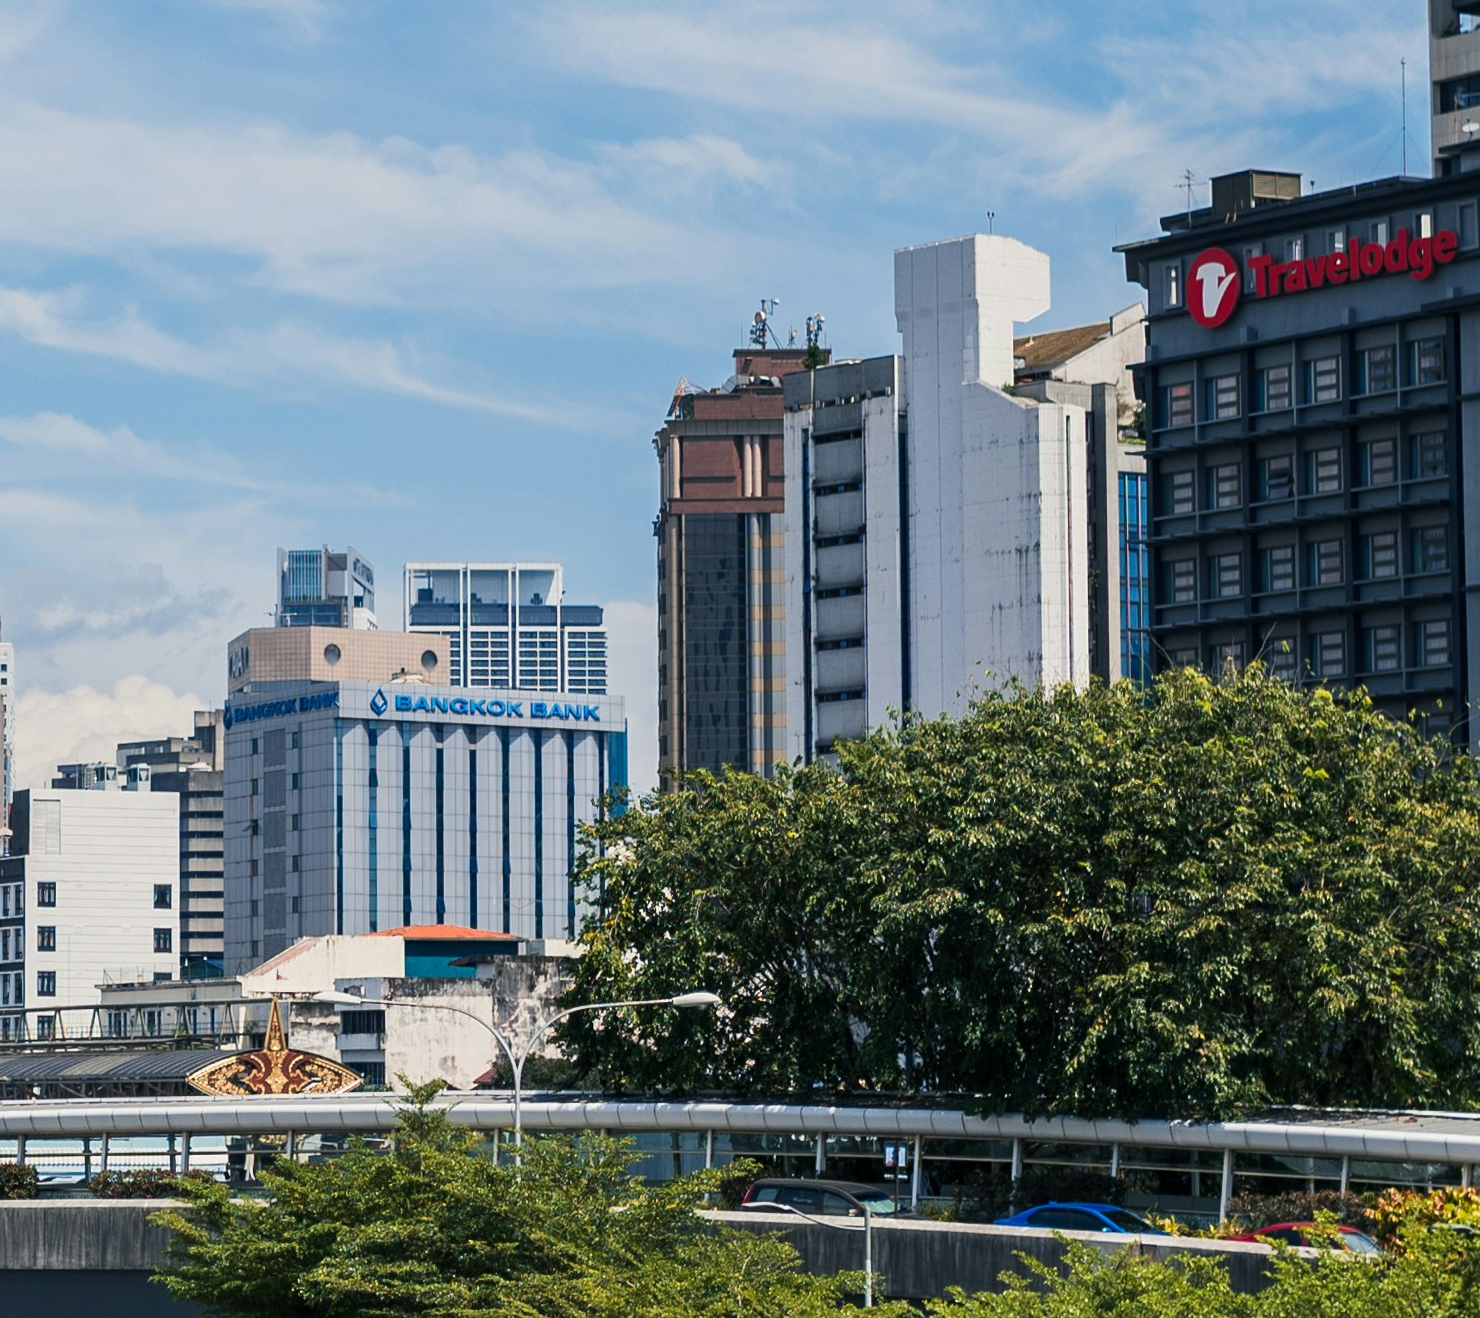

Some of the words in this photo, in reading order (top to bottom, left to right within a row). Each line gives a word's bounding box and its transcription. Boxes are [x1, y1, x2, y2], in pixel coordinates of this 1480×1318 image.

[1248, 228, 1458, 298] Travelodge
[233, 698, 298, 723] BANGKOK
[299, 691, 340, 713] BANK
[395, 694, 524, 718] BANGKOK
[530, 702, 601, 722] BANK
